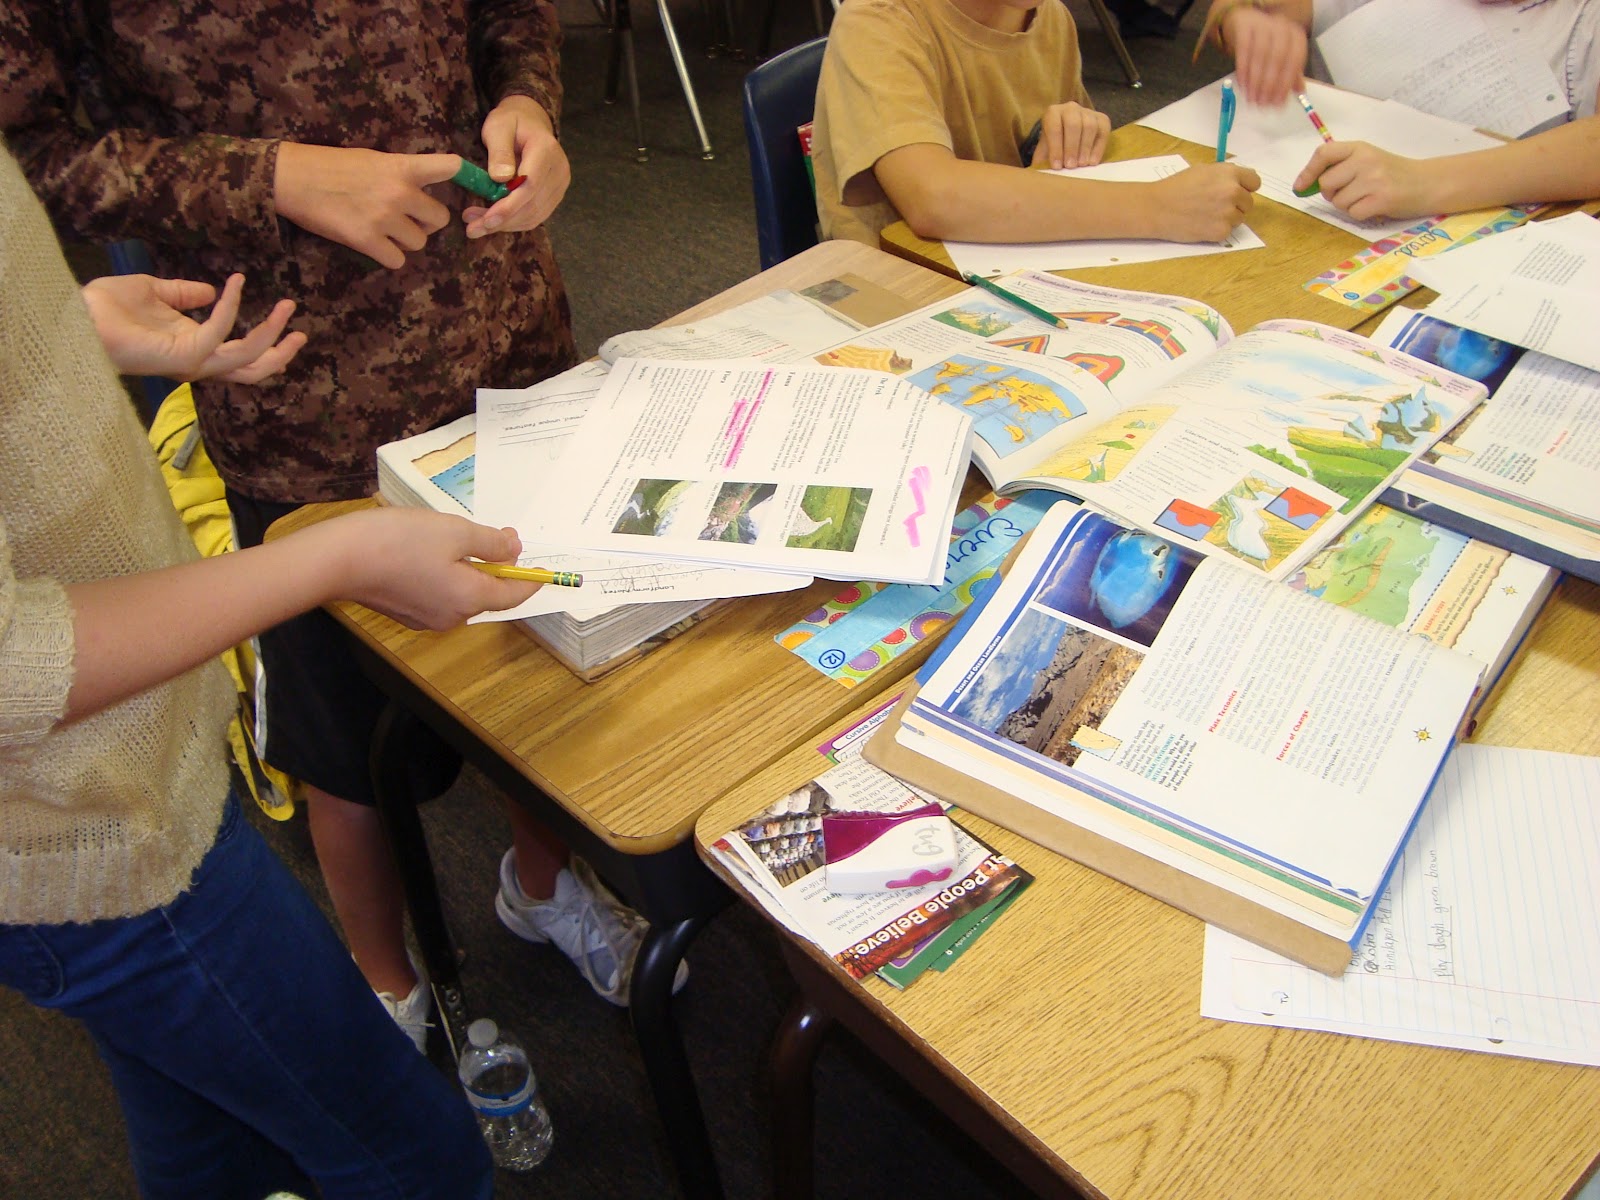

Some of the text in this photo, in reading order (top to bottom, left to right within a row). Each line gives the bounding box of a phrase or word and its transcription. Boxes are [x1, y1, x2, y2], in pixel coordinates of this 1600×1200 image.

[719, 370, 731, 384] Flora
[783, 371, 795, 386] Fauna
[879, 376, 888, 385] The
[1185, 428, 1206, 441] Glaciers
[1207, 438, 1219, 447] and
[1207, 718, 1221, 732] Plate
[1218, 689, 1237, 716] Tectonics
[846, 724, 868, 740] Cursive
[1276, 741, 1290, 760] Forces
[1287, 732, 1296, 740] of
[1293, 709, 1309, 731] Change
[1425, 850, 1438, 879] brown
[925, 869, 990, 912] People
[849, 908, 928, 958] Believe:
